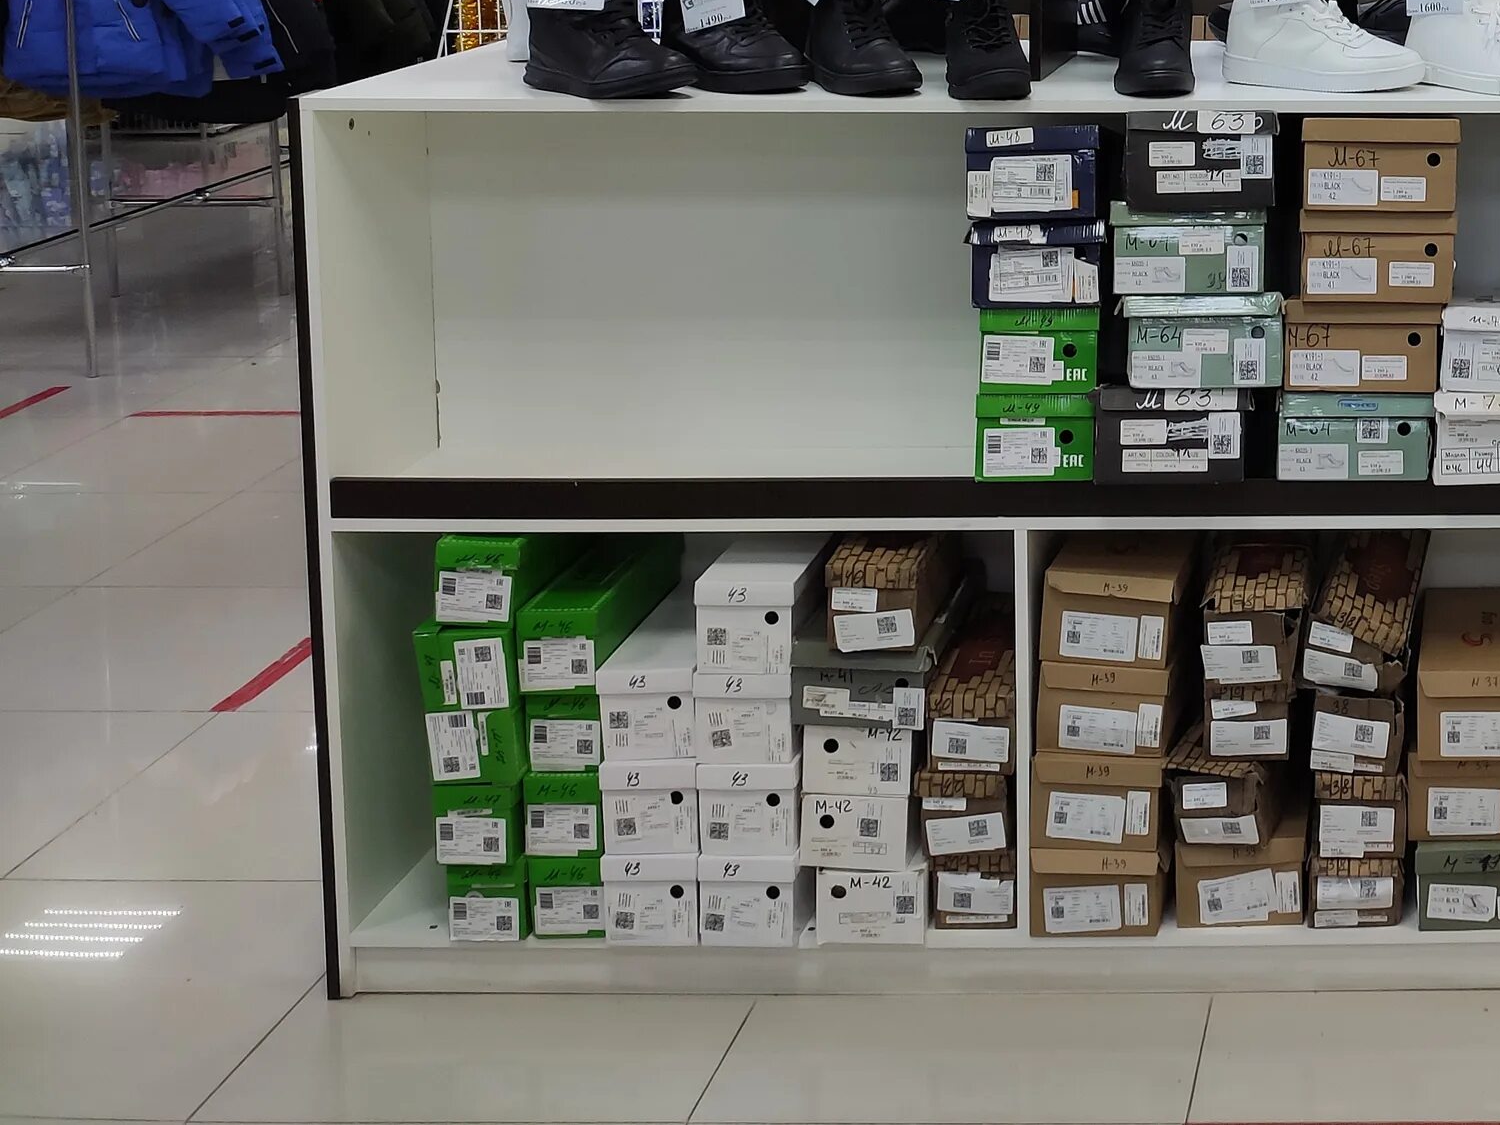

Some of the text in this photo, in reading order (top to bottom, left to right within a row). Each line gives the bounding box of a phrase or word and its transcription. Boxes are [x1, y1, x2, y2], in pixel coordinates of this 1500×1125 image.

[1419, 2, 1442, 12] 1600
[699, 13, 724, 29] 1490
[1211, 112, 1244, 130] 63
[1324, 182, 1341, 190] BLACK
[1328, 192, 1336, 200] 42
[1066, 368, 1087, 381] EAC
[1175, 388, 1211, 407] 63
[1063, 454, 1084, 467] EAC
[728, 587, 747, 603] 43
[629, 675, 646, 688] 43
[725, 676, 742, 693] 43
[1333, 699, 1349, 715] 38
[627, 772, 640, 787] 43
[731, 771, 749, 787] 43
[624, 862, 640, 876] 43
[722, 862, 740, 878] 43
